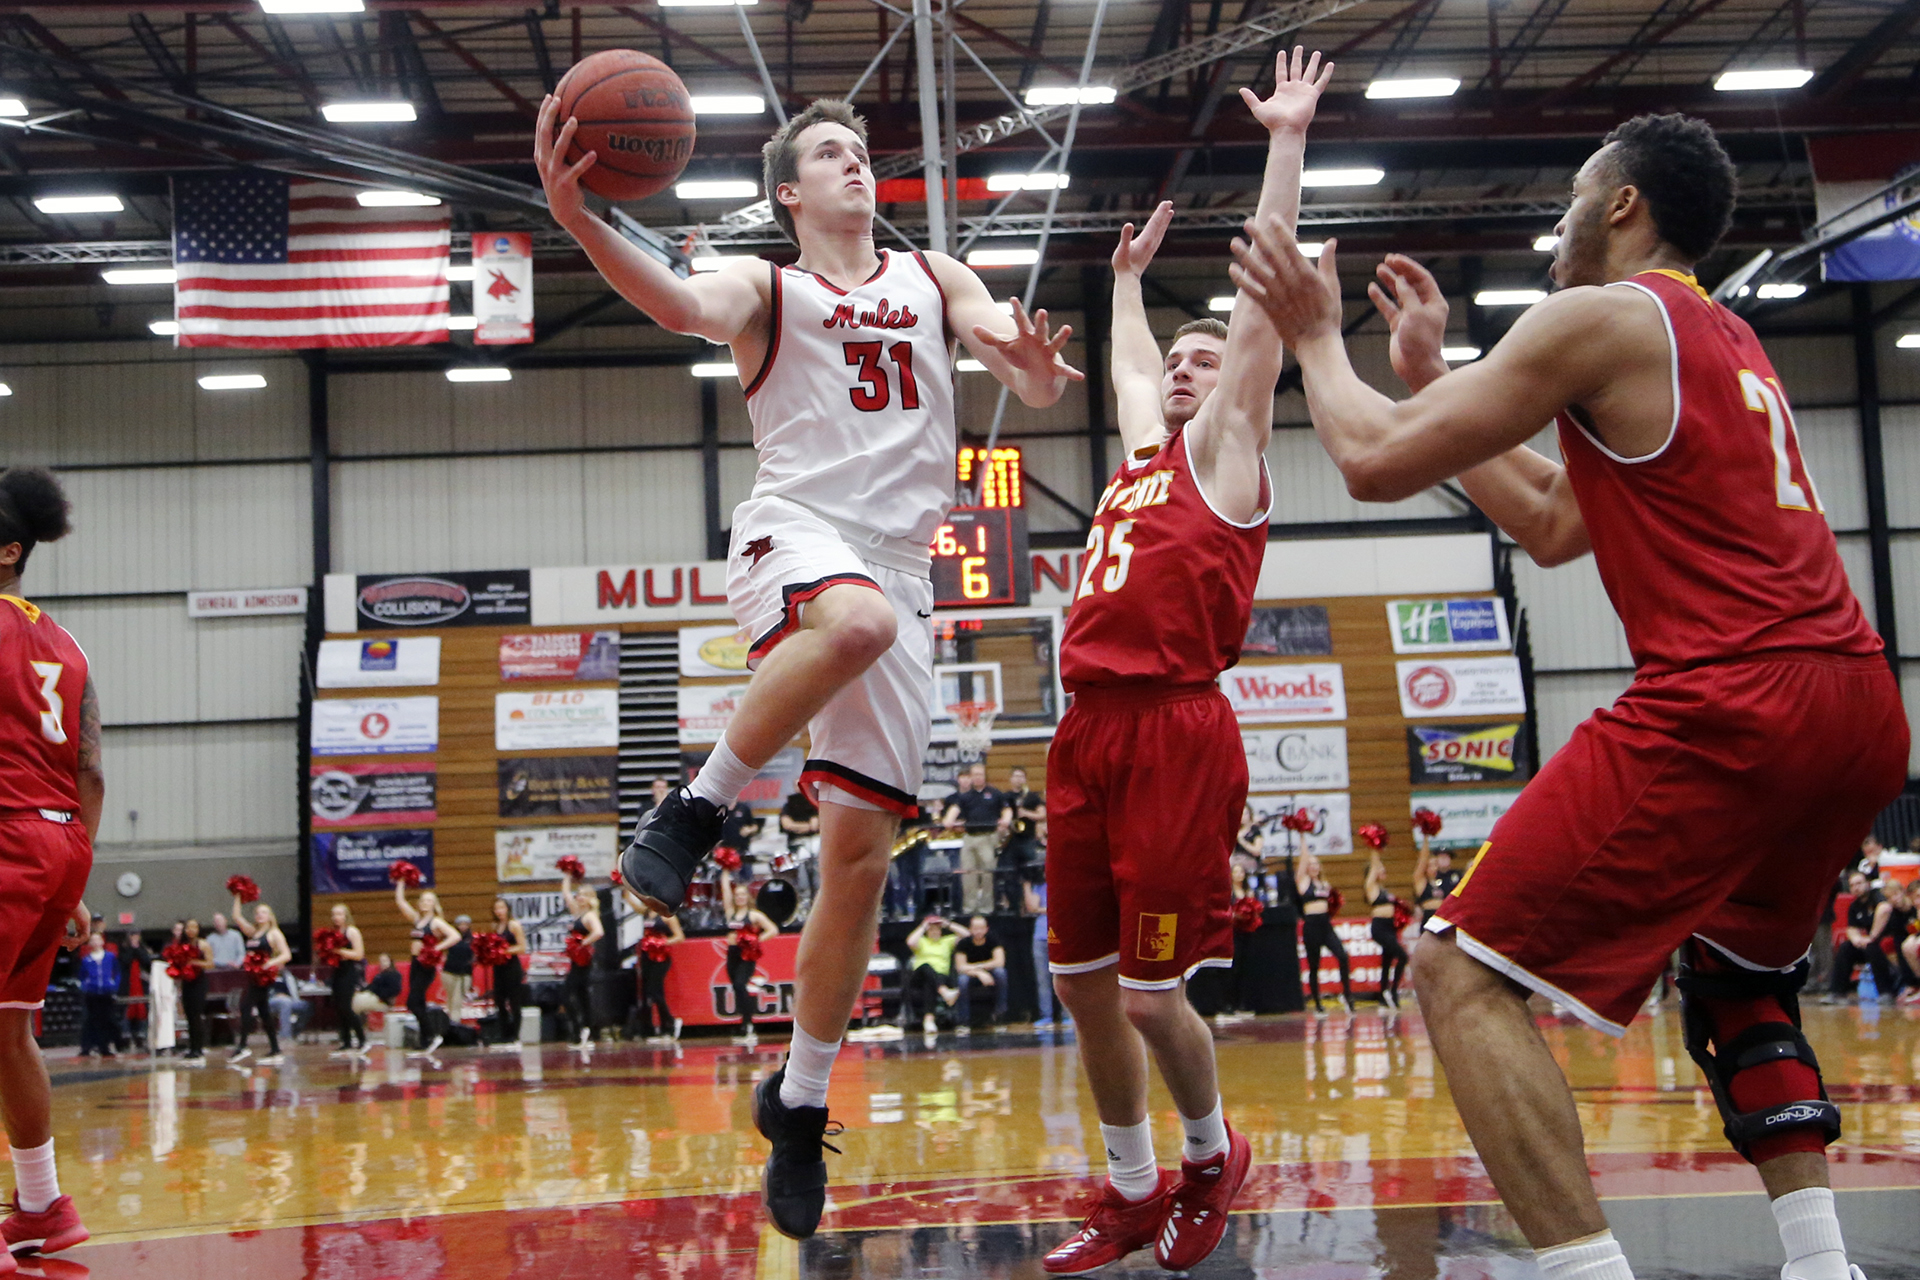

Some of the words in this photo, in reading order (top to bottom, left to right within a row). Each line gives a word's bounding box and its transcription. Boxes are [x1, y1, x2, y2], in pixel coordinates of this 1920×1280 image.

[607, 132, 692, 164] Wilson
[823, 298, 918, 329] Mules
[842, 340, 919, 412] 31
[1738, 369, 1825, 515] 2
[1078, 518, 1138, 600] 25
[596, 567, 729, 609] MUL
[962, 556, 990, 599] 6
[196, 597, 238, 610] GENERAL
[245, 594, 299, 607] ADMISSION
[373, 601, 441, 616] COLLISION
[30, 660, 67, 744] 3
[1234, 673, 1334, 701] Woods
[1427, 739, 1511, 760] SONIC
[382, 845, 429, 859] Campus
[1765, 1104, 1825, 1126] DONJOY
